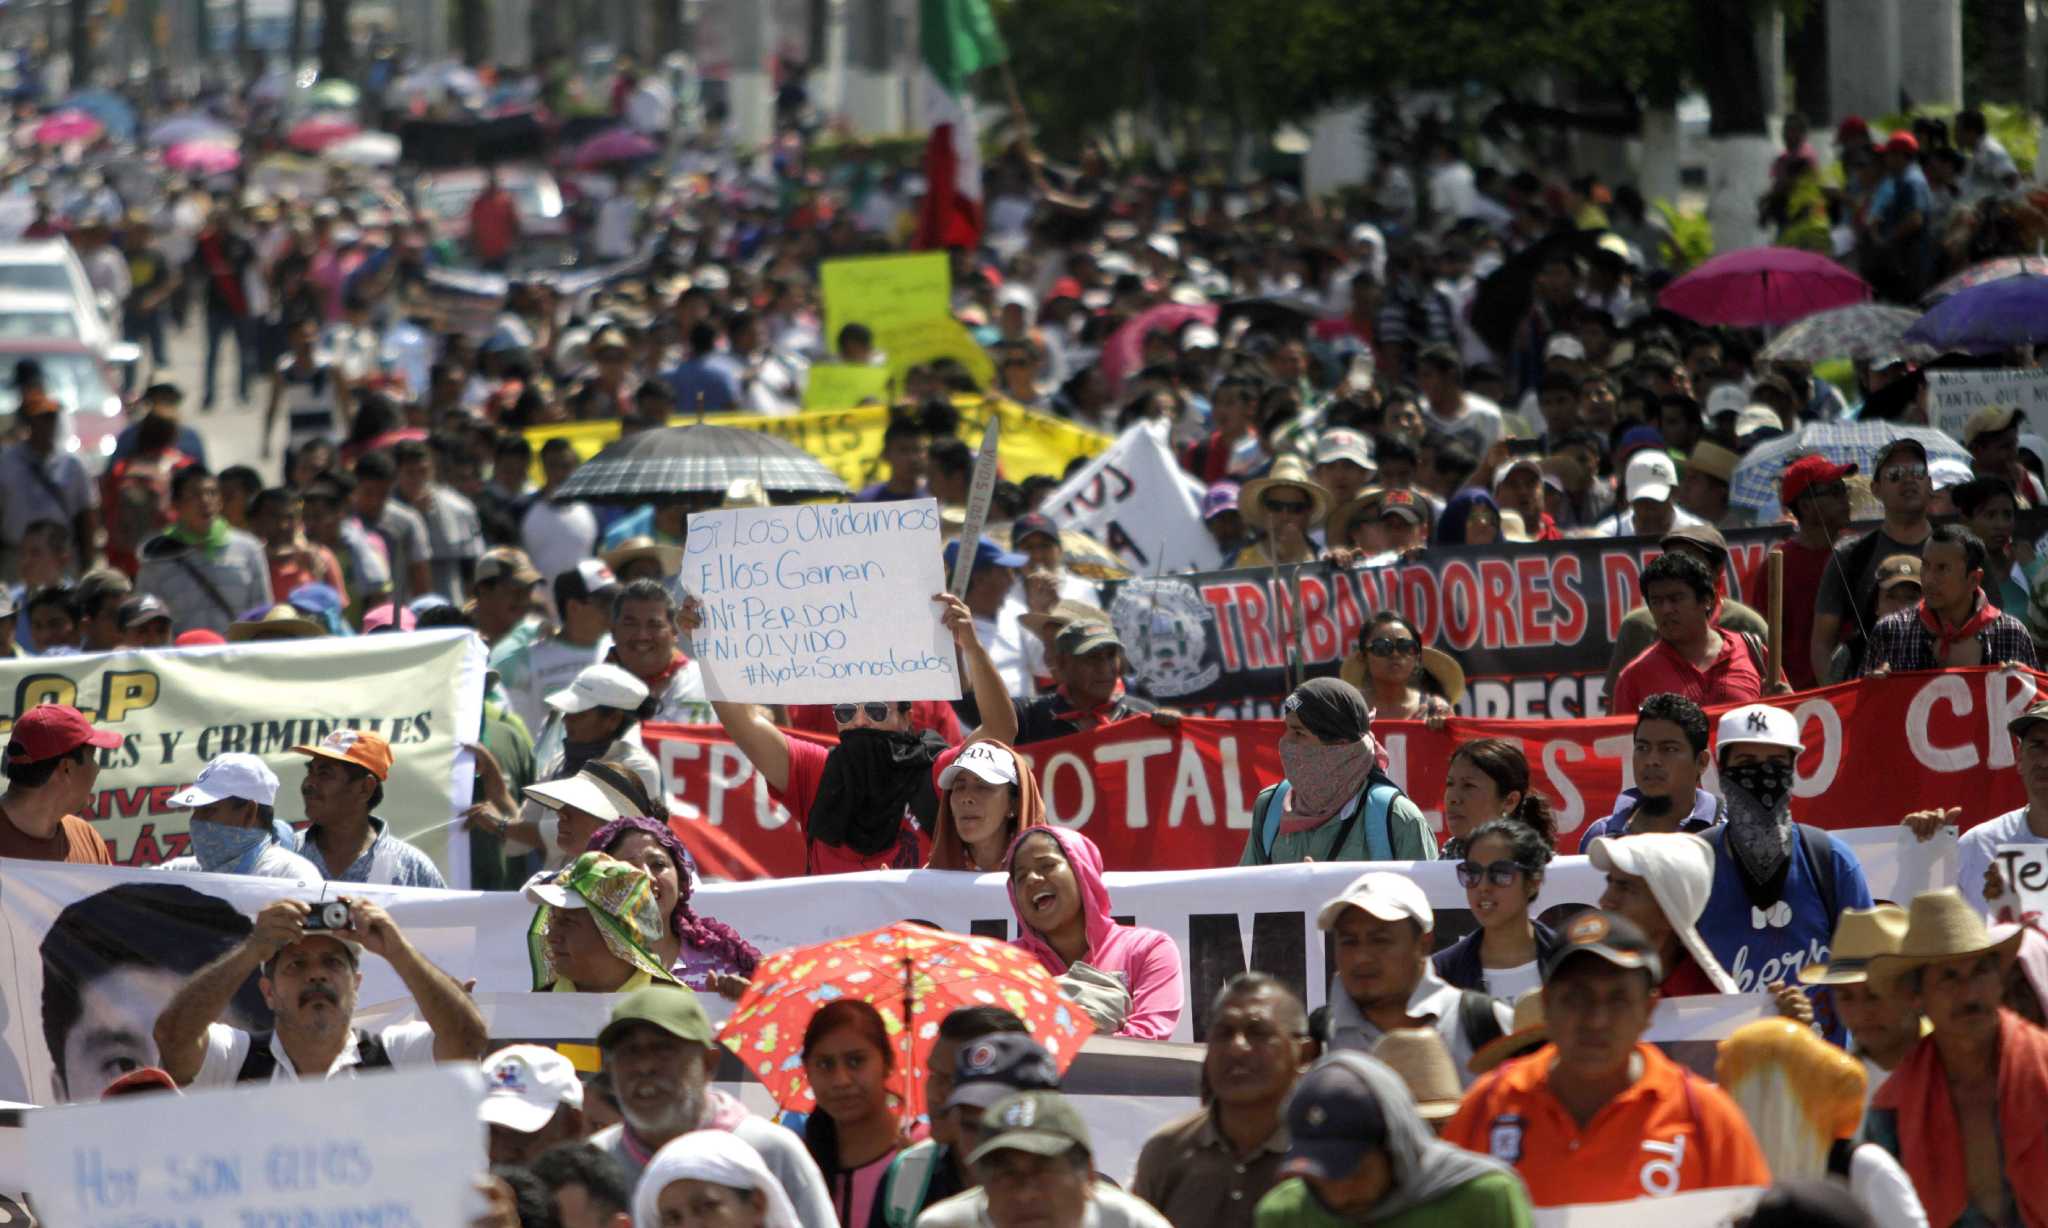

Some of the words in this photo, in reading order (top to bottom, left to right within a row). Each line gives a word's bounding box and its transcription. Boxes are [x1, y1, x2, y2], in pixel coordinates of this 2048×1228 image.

[796, 504, 939, 543] Olvidamos
[775, 549, 887, 590] Ganan
[160, 731, 184, 764] Y
[1023, 735, 1256, 831] OTAL
